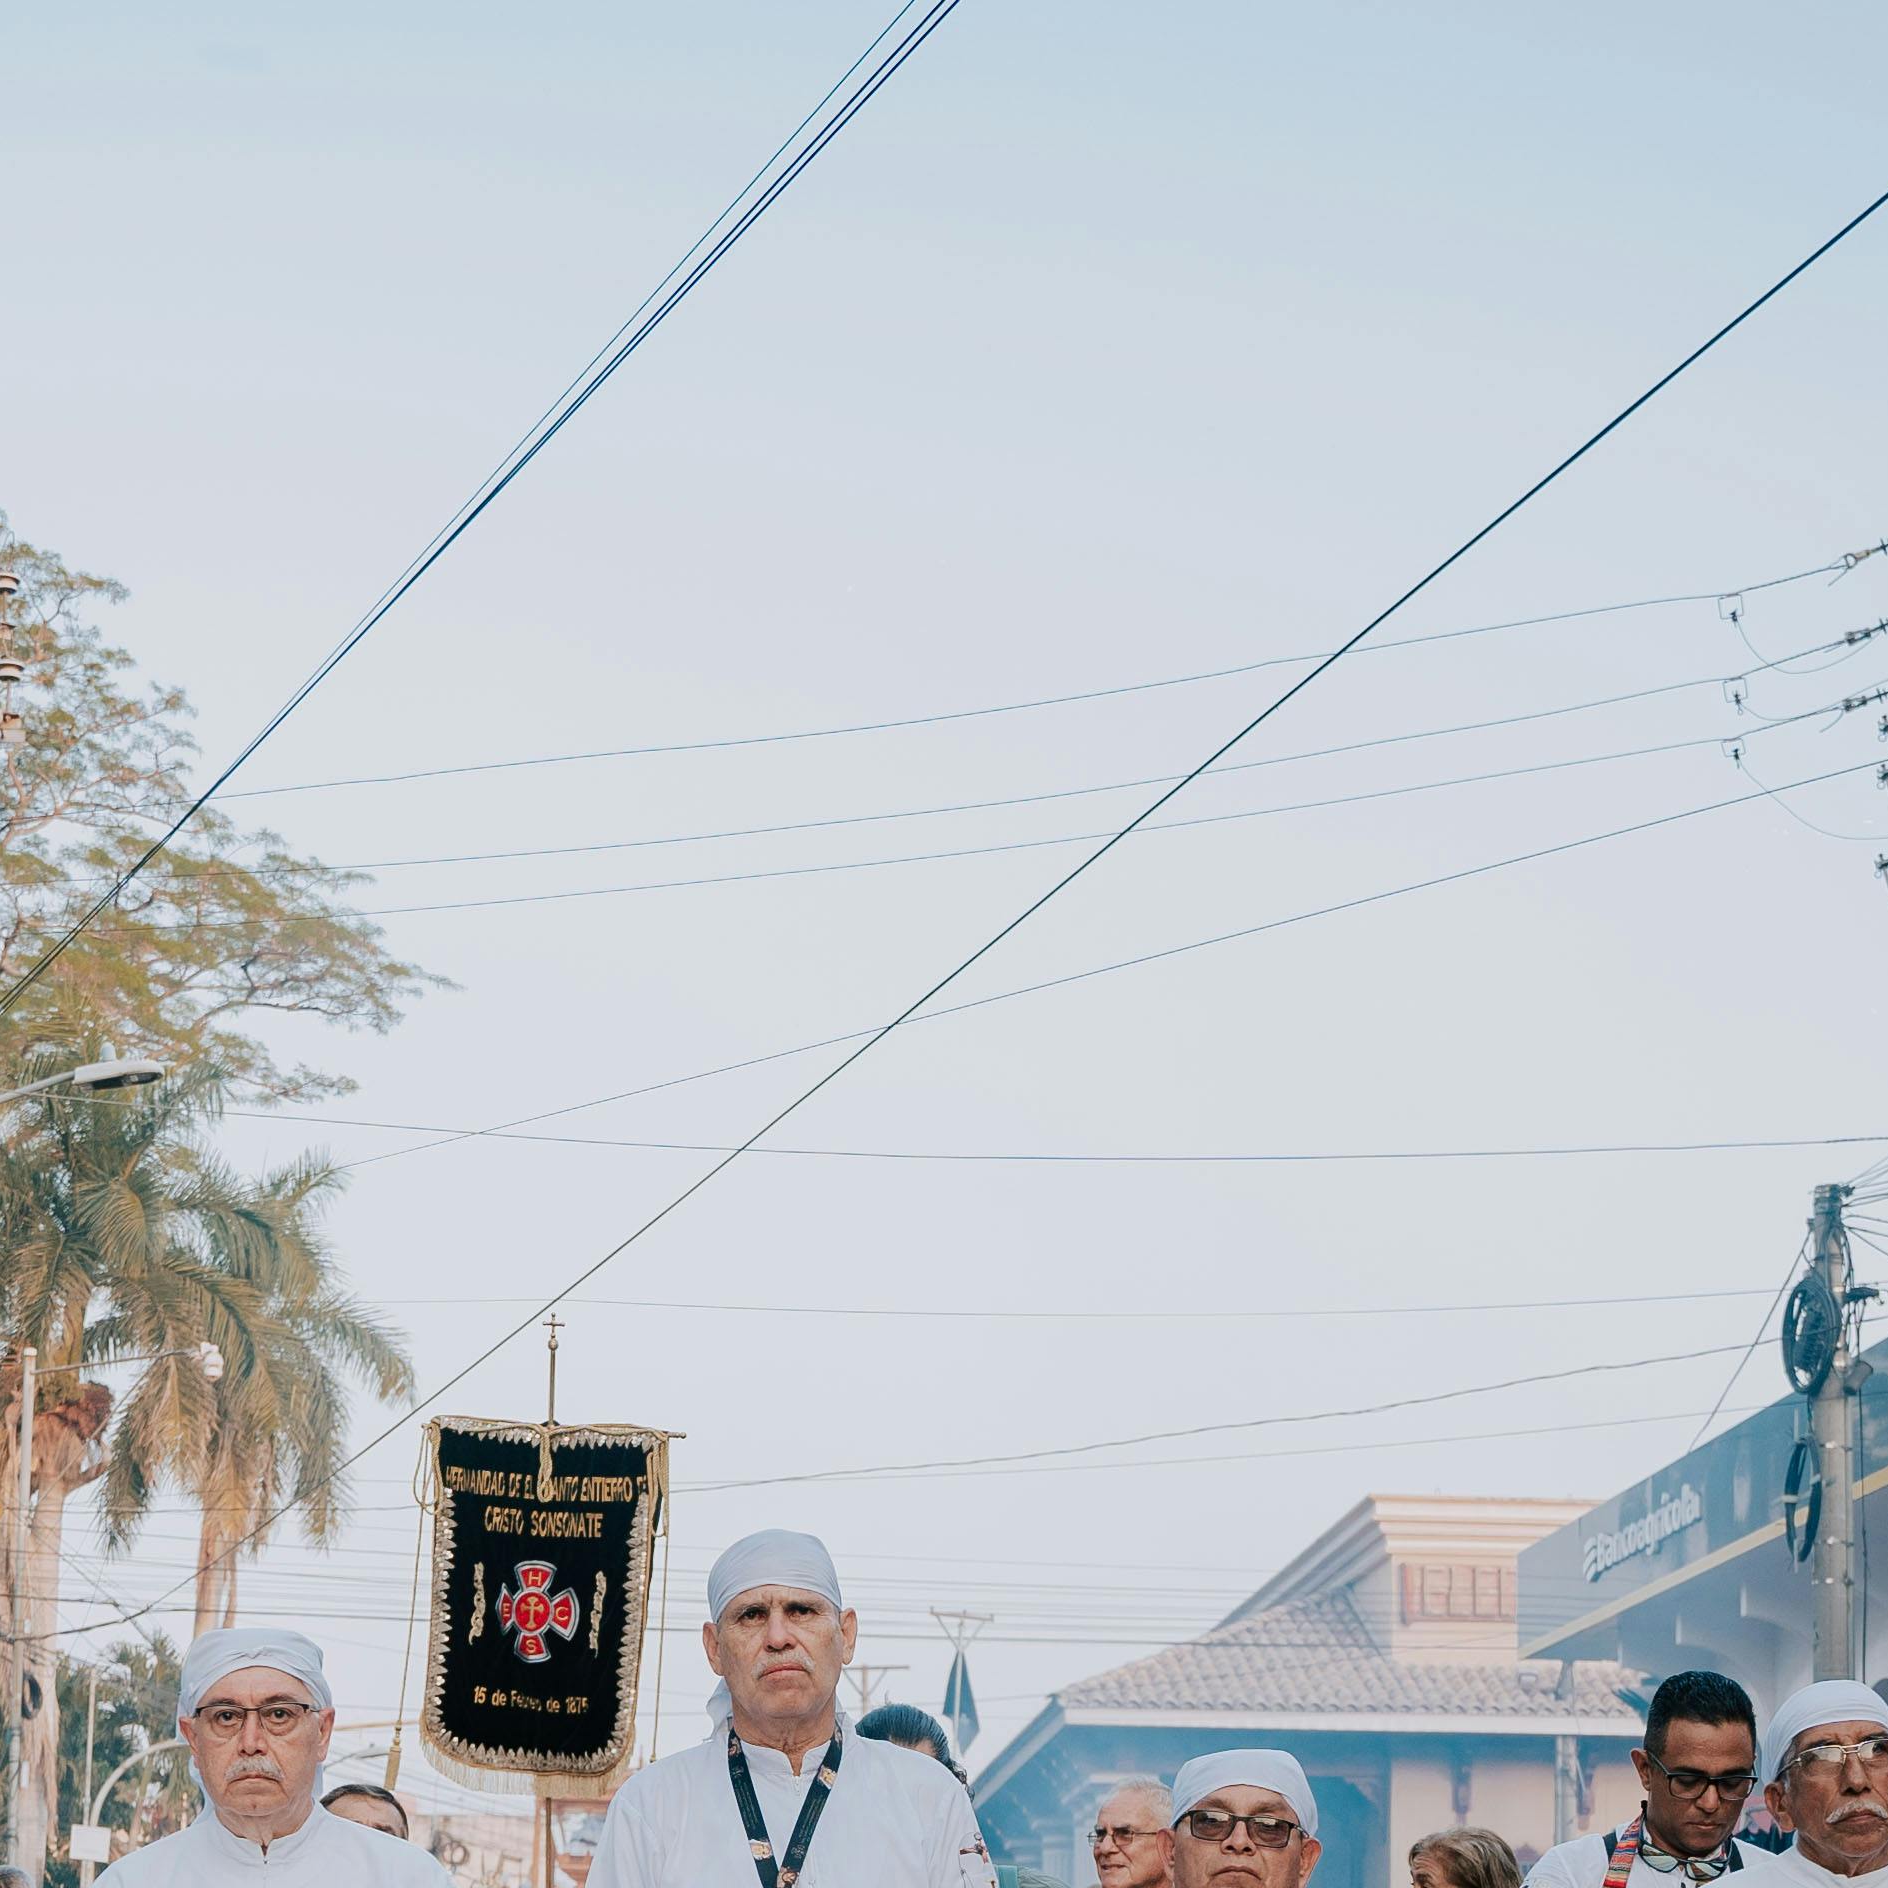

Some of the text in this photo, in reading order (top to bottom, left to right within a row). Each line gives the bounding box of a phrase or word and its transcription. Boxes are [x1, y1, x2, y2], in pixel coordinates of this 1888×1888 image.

[524, 1473, 535, 1500] EL
[549, 1475, 578, 1502] ANTO
[581, 1476, 633, 1503] ENTIERRO
[484, 1505, 604, 1539] CRISTO SONSONATE
[527, 1571, 542, 1587] H
[502, 1602, 569, 1621] E C
[525, 1639, 537, 1654] S
[473, 1685, 488, 1705] 15
[491, 1689, 508, 1707] de
[546, 1697, 561, 1713] de
